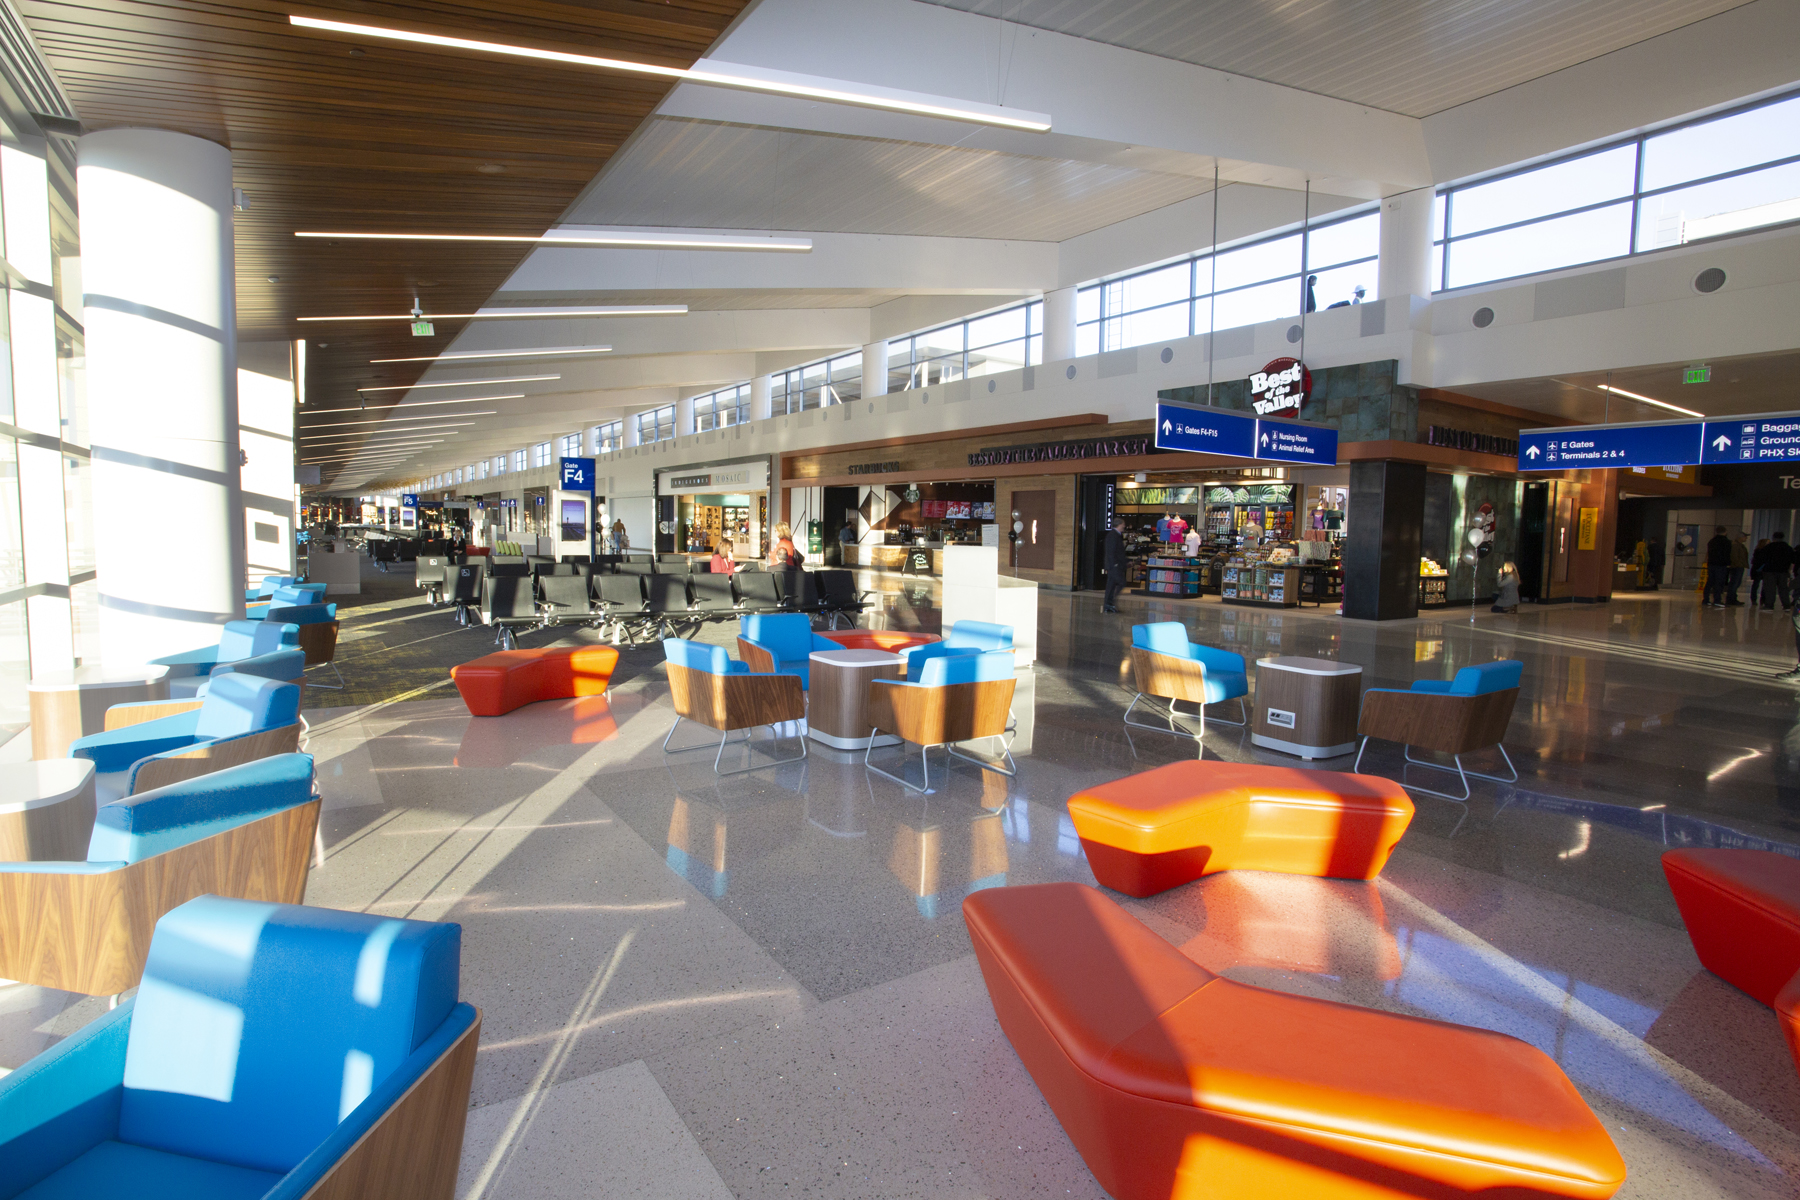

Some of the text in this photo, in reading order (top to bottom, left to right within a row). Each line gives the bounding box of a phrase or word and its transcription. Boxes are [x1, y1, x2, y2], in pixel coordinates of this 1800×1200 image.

[415, 323, 431, 335] EXIT
[1249, 362, 1301, 395] Best
[1687, 369, 1707, 384] EXIT
[1264, 385, 1291, 400] of the
[1252, 392, 1304, 415] Valley
[1184, 425, 1219, 438] Gates F4-F15
[1278, 432, 1308, 443] Nursing Room
[1278, 443, 1315, 454] Animal Relief Area
[1561, 441, 1595, 449] E Gates
[967, 438, 1148, 468] BEST OF THE VALLEY MARKET
[1560, 449, 1626, 460] Terminals 2 & 4
[1759, 448, 1785, 458] PHX
[848, 461, 900, 476] STARBUCKS
[564, 469, 584, 484] F4
[715, 473, 742, 483] MOSAIC
